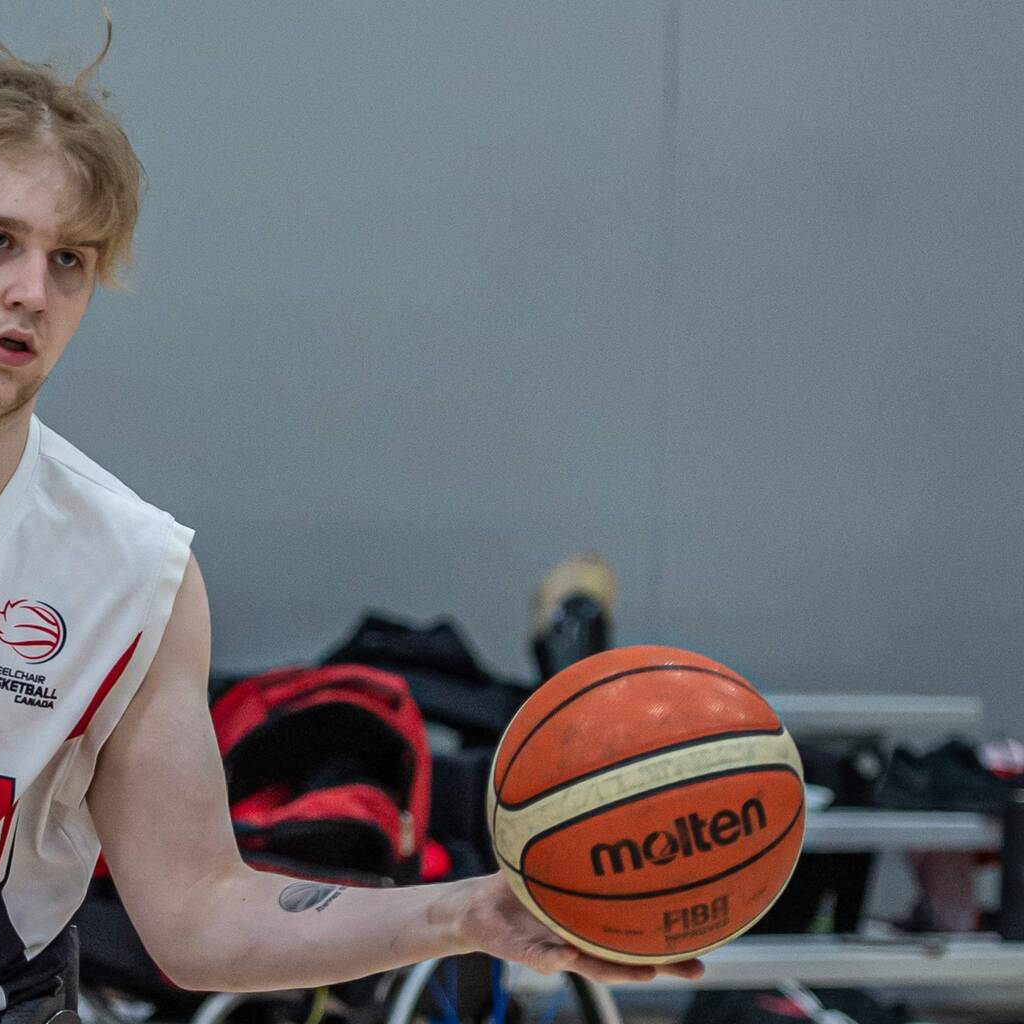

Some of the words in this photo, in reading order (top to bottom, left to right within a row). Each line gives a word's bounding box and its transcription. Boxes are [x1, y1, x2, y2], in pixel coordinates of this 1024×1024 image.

[14, 695, 54, 709] CANADA
[591, 799, 767, 876] molten
[662, 894, 729, 933] FIBA
